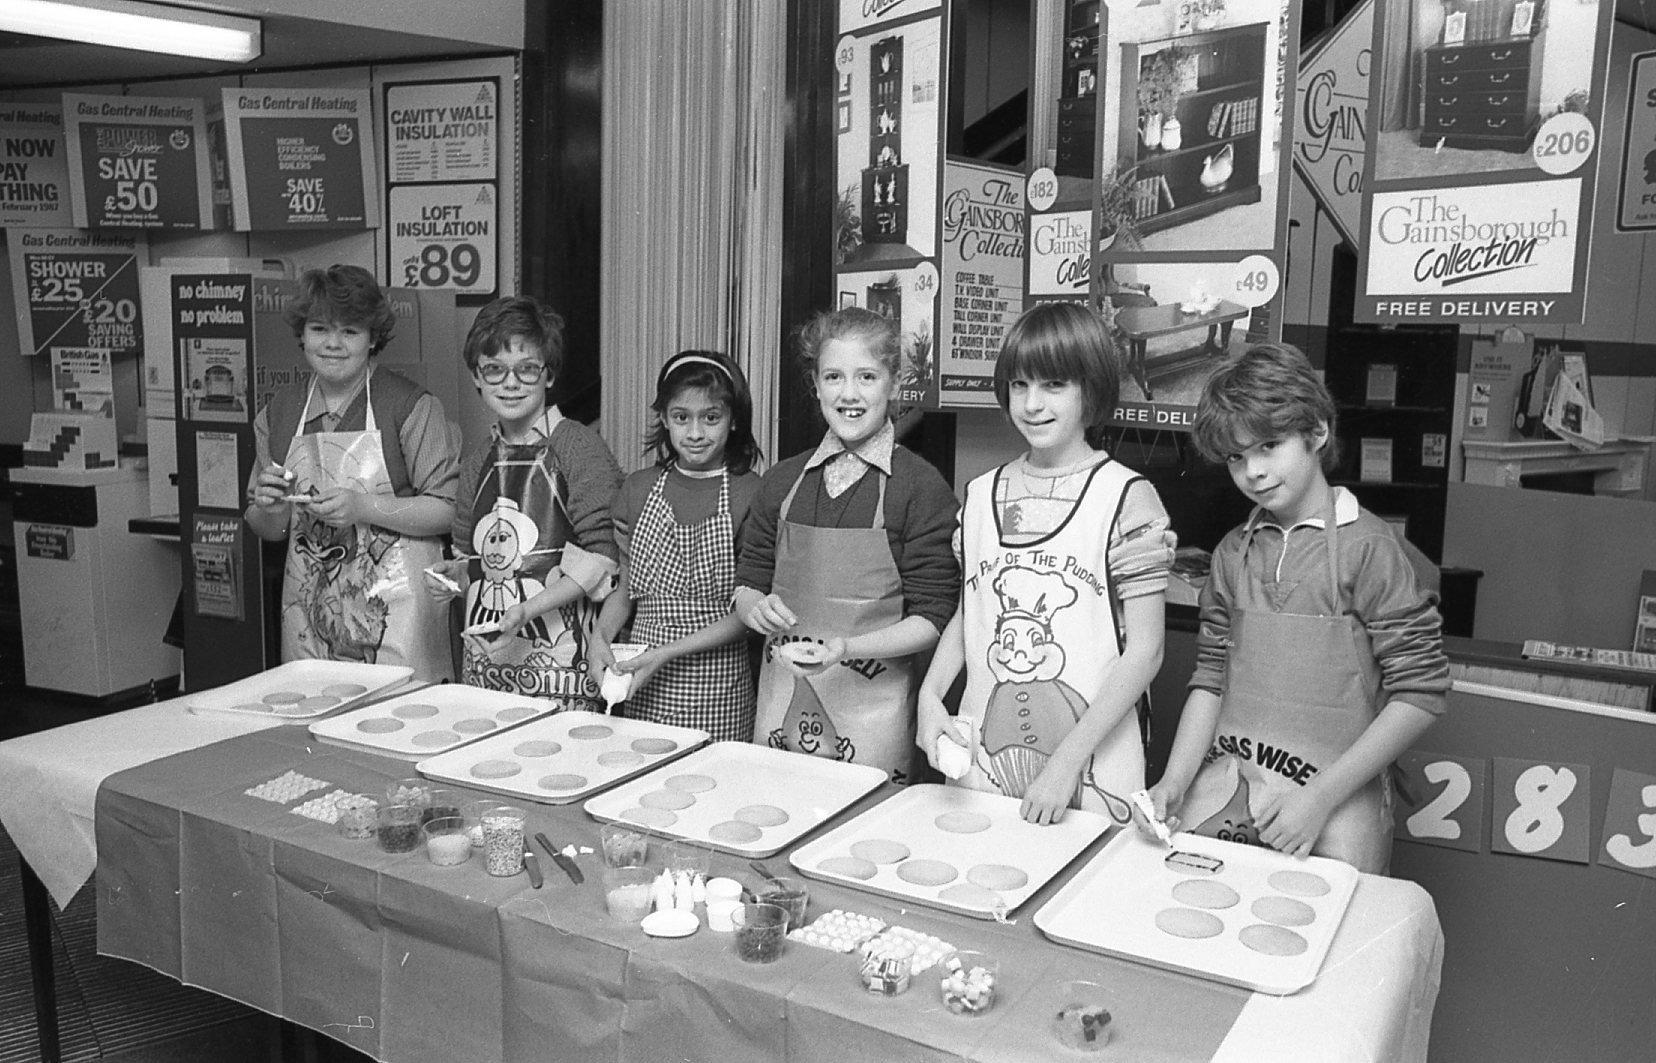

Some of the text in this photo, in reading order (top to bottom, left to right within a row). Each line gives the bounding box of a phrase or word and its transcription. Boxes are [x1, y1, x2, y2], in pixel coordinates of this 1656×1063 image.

[77, 102, 194, 121] Gas Central Heating
[239, 95, 357, 112] Gas Central Heating
[17, 110, 61, 126] Heating
[391, 105, 494, 125] CAVITY WALL
[396, 122, 489, 140] INSULATION
[6, 138, 56, 157] NOW
[1536, 129, 1590, 158] £206
[99, 157, 158, 180] SAVE
[104, 180, 158, 211] £50
[287, 178, 324, 193] SAVE
[982, 179, 1019, 206] The
[289, 193, 326, 213] 40%
[421, 205, 462, 220] LOFT
[1410, 196, 1460, 222] The
[944, 188, 1024, 242] GAINSBOR
[1378, 205, 1569, 246] Gainsborough
[396, 221, 488, 237] INSULATION
[1053, 217, 1083, 238] The
[22, 234, 43, 247] Gas
[45, 235, 90, 248] Central
[960, 229, 1024, 262] Collecti
[404, 243, 481, 287] £89
[1414, 234, 1538, 282] Collection
[31, 261, 106, 278] SHOWER
[1056, 253, 1091, 285] Colle
[31, 278, 83, 302] £25
[179, 280, 246, 302] no chimney
[915, 274, 934, 291] £34
[1236, 270, 1269, 292] £49
[84, 299, 137, 323] £20
[180, 305, 244, 327] no problem
[1375, 301, 1556, 317] FREE DELIVERY
[88, 324, 134, 336] SAVING
[88, 336, 136, 348] OFFERS
[270, 371, 291, 387] you
[1113, 408, 1149, 422] REE
[1005, 552, 1021, 565] OF
[1027, 550, 1058, 568] THE
[1065, 555, 1106, 597] PUDDING
[1256, 741, 1318, 787] WISE
[1406, 760, 1472, 839] 2
[1504, 764, 1577, 853] 8
